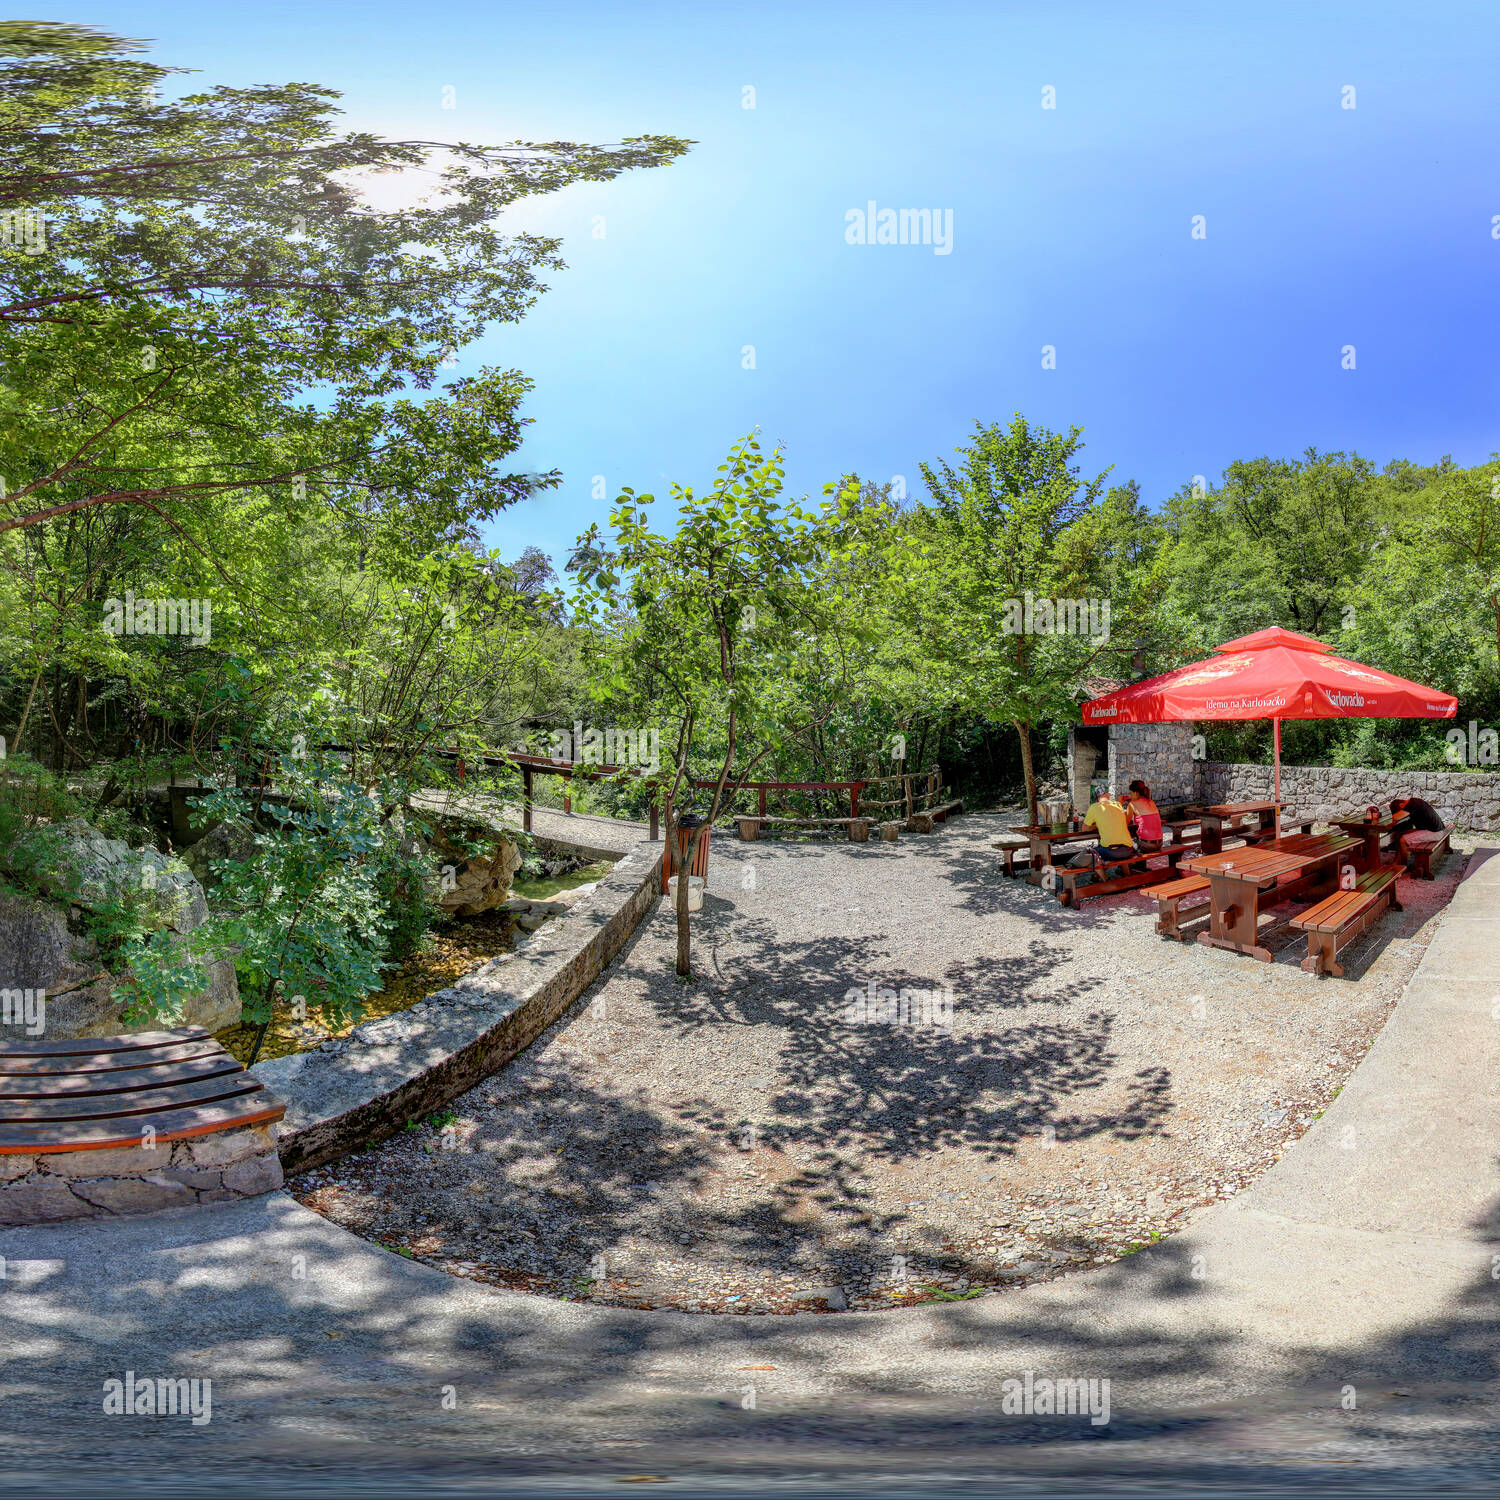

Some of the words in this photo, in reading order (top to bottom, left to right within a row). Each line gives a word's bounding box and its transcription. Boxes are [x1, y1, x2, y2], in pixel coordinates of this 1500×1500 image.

[1206, 700, 1228, 709] Idemo
[1230, 701, 1239, 709] na
[1242, 696, 1286, 707] Karlovačko
